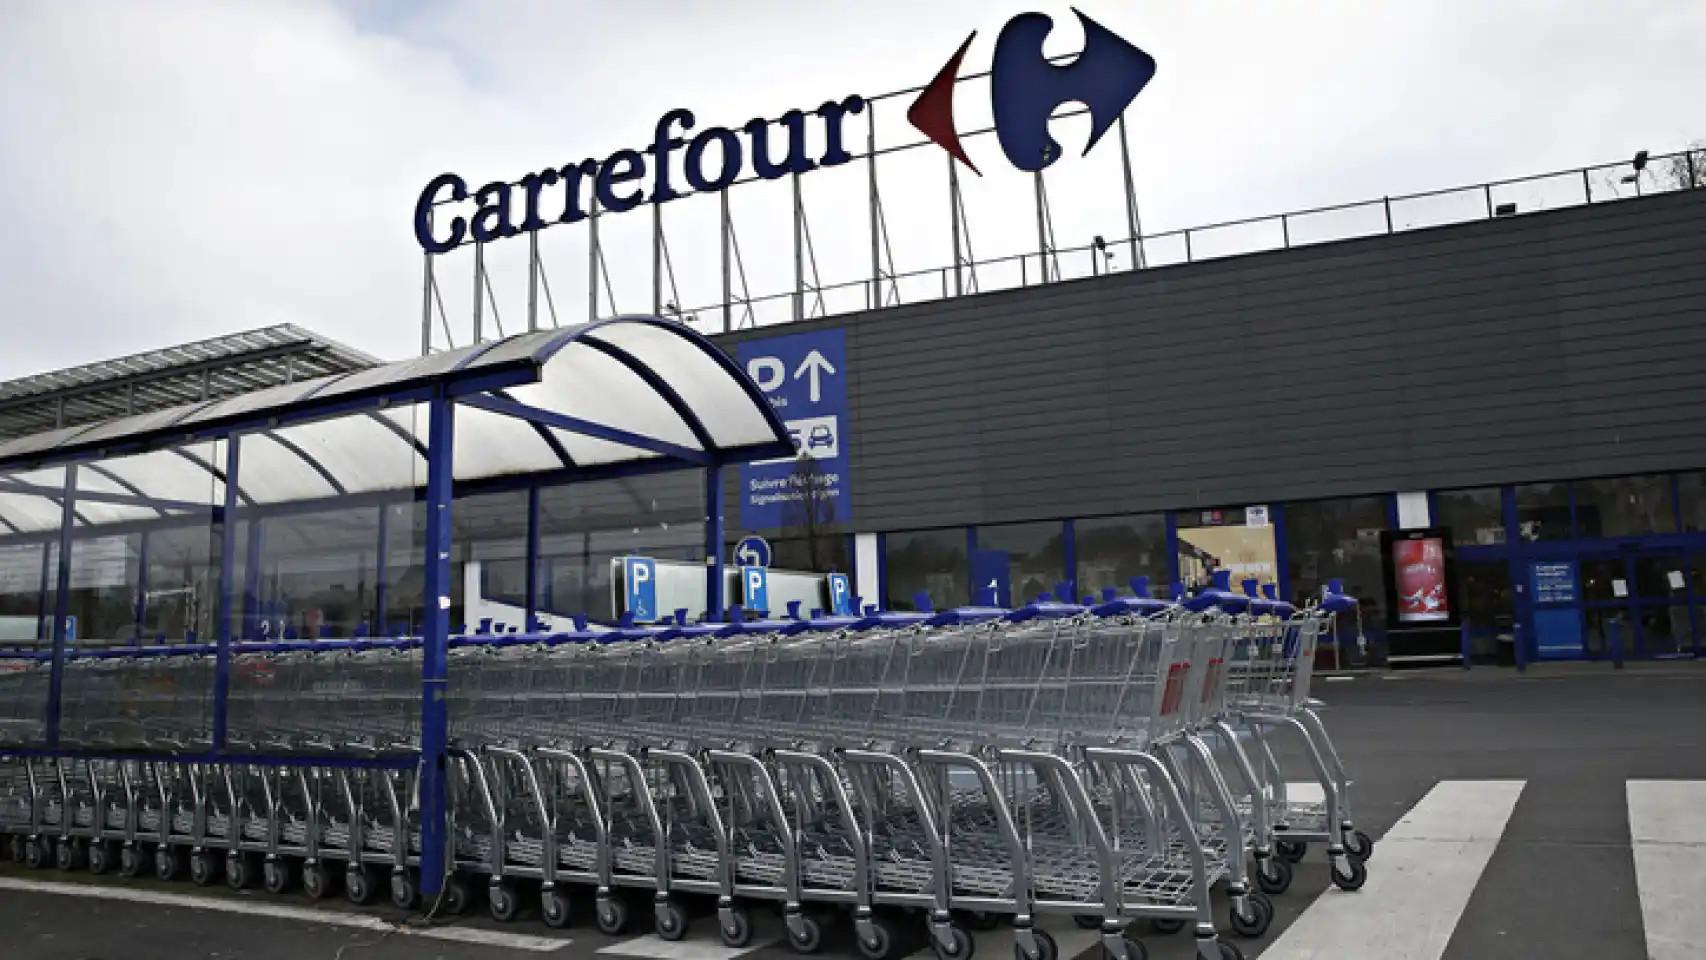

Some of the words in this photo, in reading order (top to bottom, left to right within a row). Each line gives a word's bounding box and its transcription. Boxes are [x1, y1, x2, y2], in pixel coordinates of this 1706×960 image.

[413, 94, 866, 254] Carrefour
[633, 563, 649, 595] P
[750, 572, 762, 600] P
[833, 577, 844, 604] P
